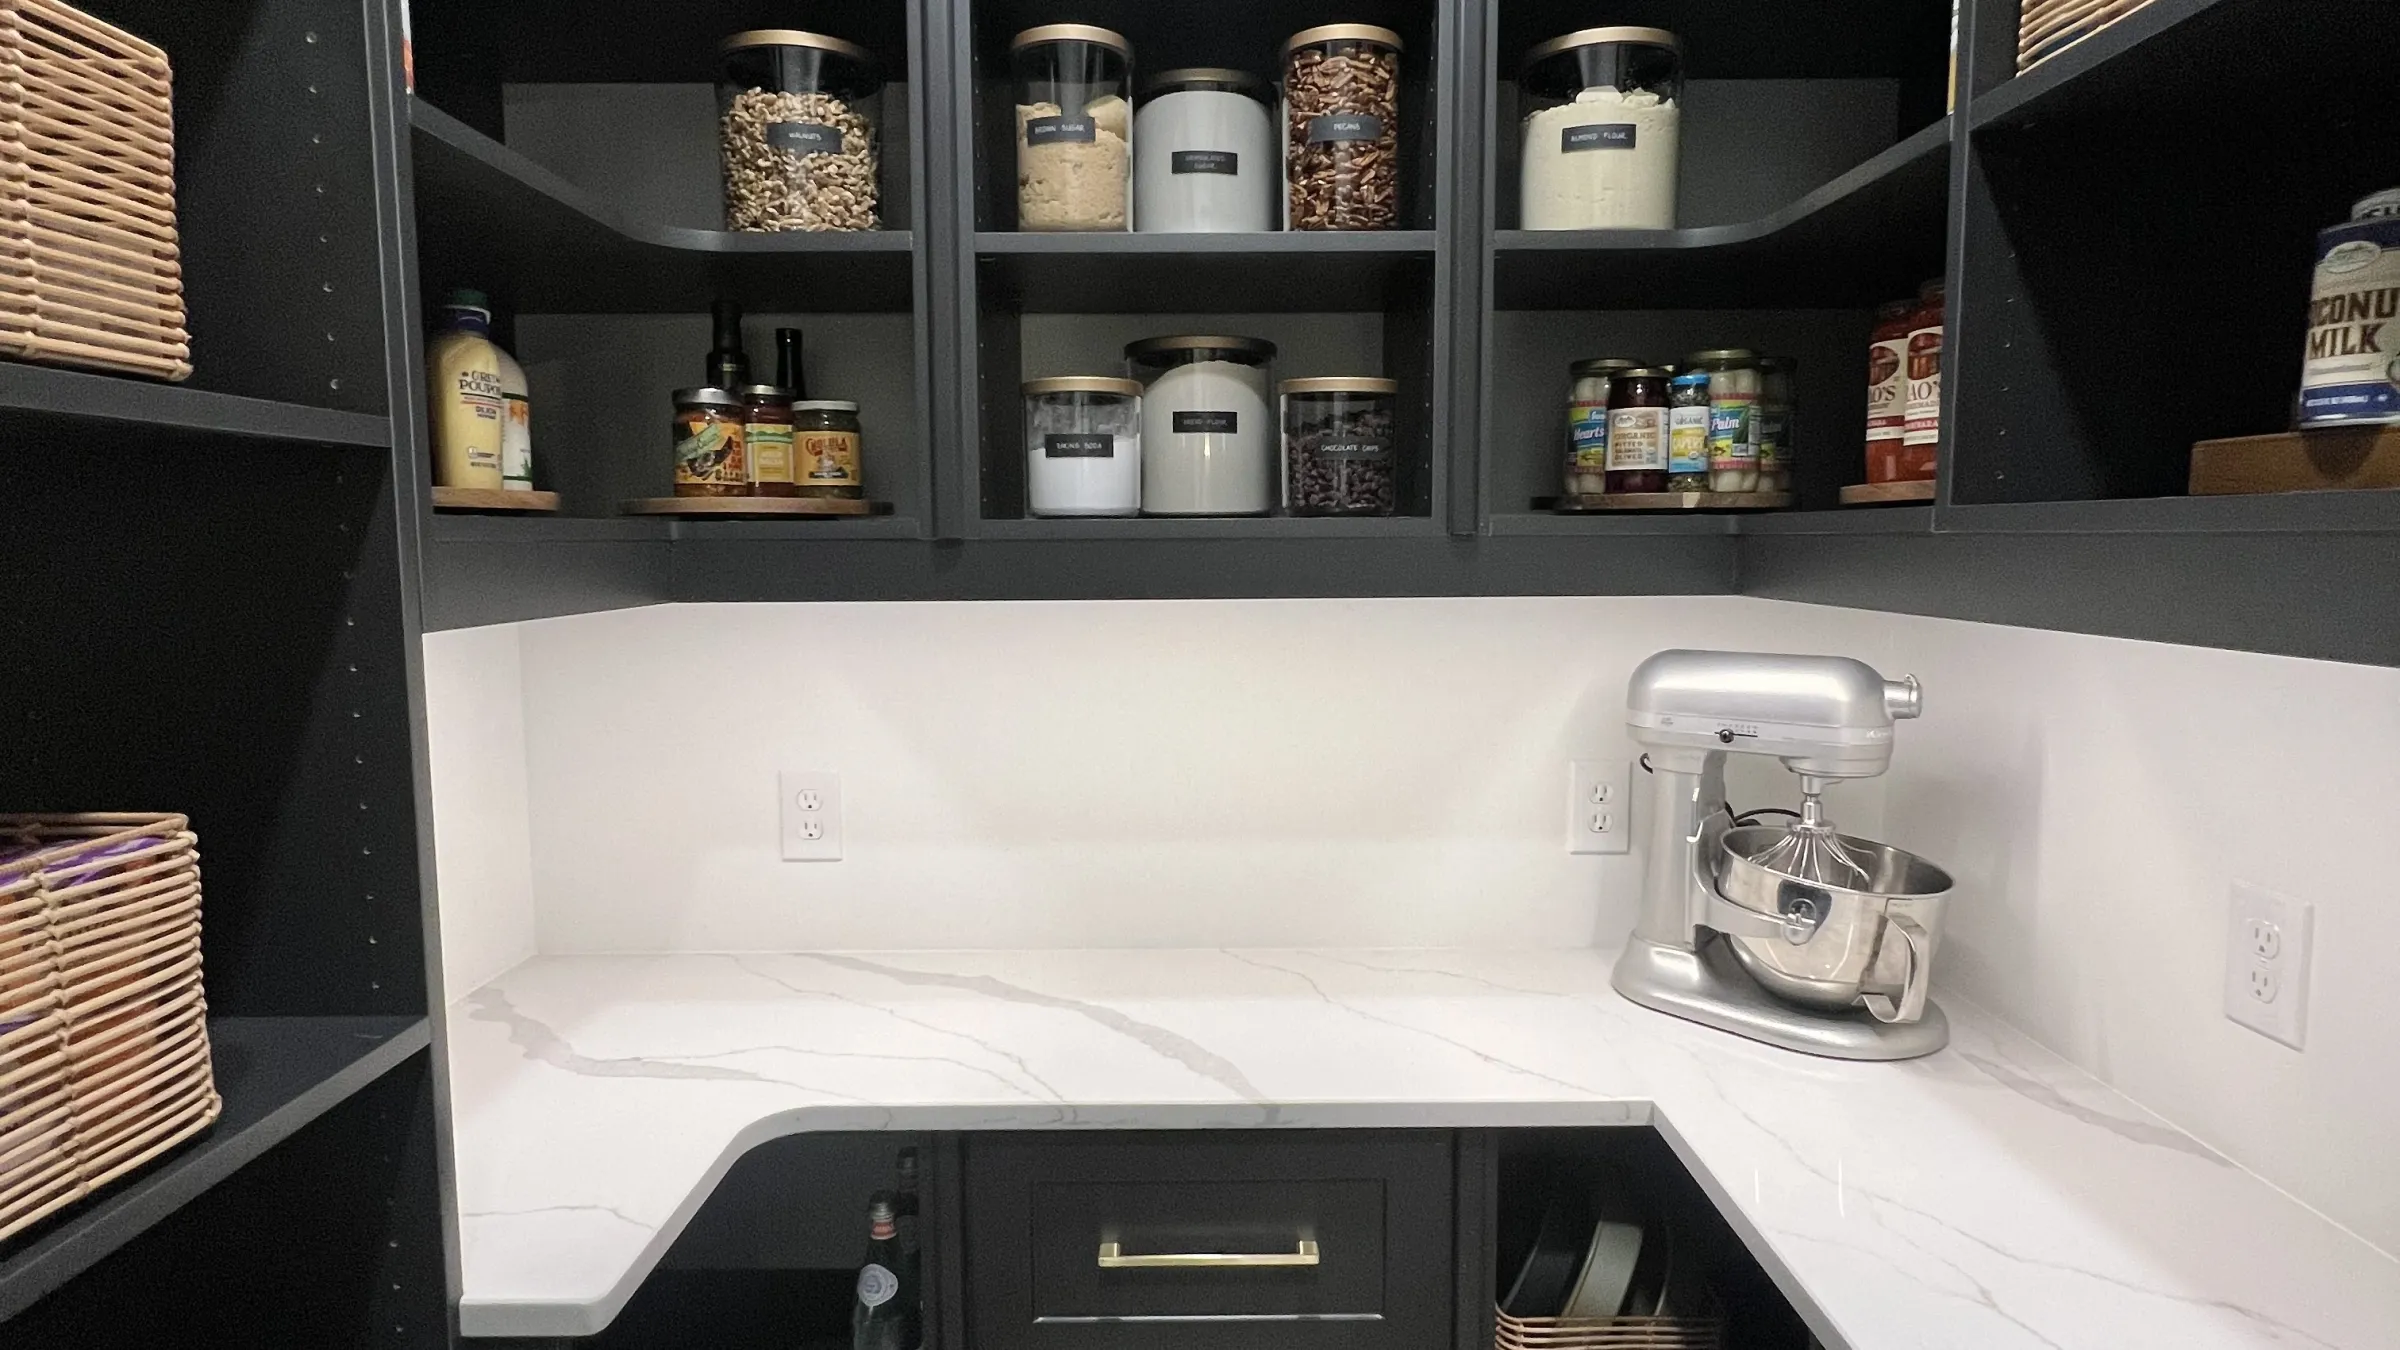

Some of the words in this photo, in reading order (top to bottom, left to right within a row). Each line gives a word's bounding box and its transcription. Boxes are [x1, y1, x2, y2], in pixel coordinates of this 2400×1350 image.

[2308, 321, 2388, 360] MILK
[1711, 416, 1740, 431] Palm
[1573, 426, 1605, 441] Hearts
